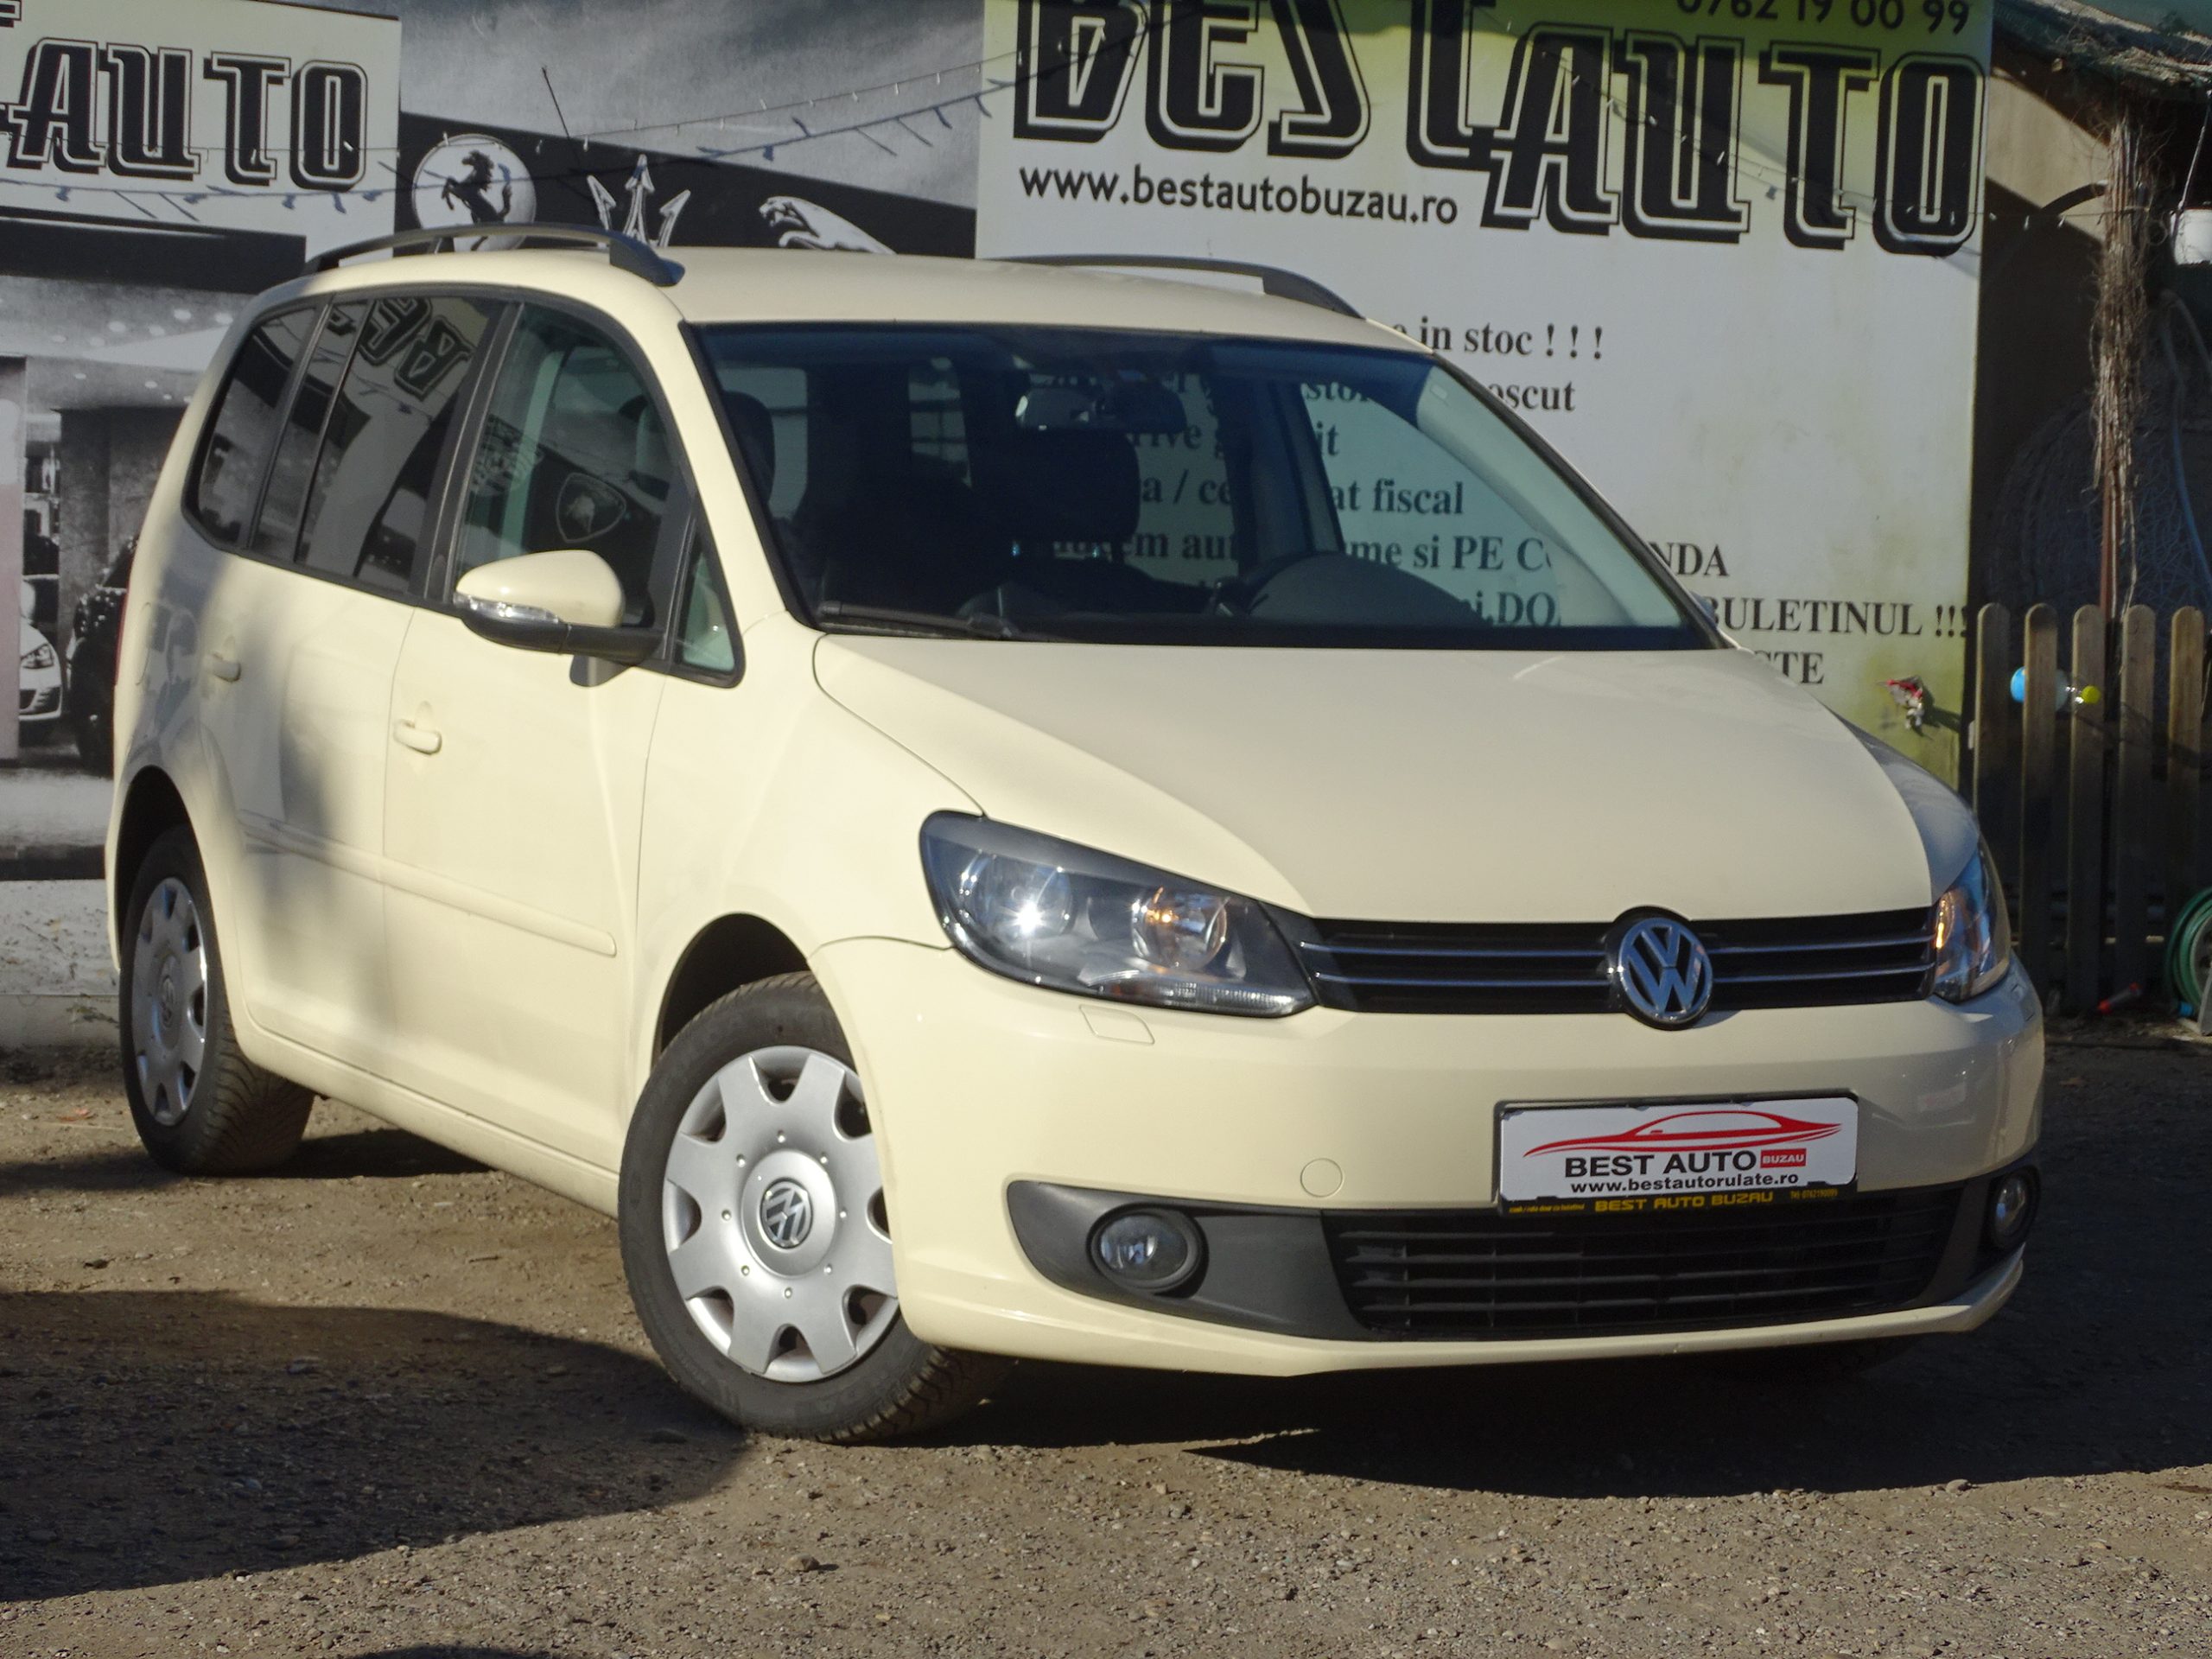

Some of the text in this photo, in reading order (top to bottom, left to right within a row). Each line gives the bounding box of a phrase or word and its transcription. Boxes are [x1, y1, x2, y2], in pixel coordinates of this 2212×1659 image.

[1851, 0, 1904, 29] 00
[1923, 0, 1970, 35] 99
[7, 36, 369, 191] AUTO
[1479, 21, 1986, 257] AUTO
[1020, 164, 1459, 226] www.bestautobuzau.ro
[1420, 315, 1452, 351] in
[1464, 322, 1533, 356] stoc
[1372, 477, 1465, 515] fiscal
[1413, 534, 1440, 569] si
[1452, 535, 1504, 571] PE
[1565, 1148, 1805, 1179] BEST AUTO BUZAU
[1571, 1172, 1800, 1193] www.bestautorulate.ro
[1594, 1198, 1647, 1213] BEST
[1654, 1194, 1706, 1210] AUTO
[1712, 1191, 1774, 1207] BUZAU
